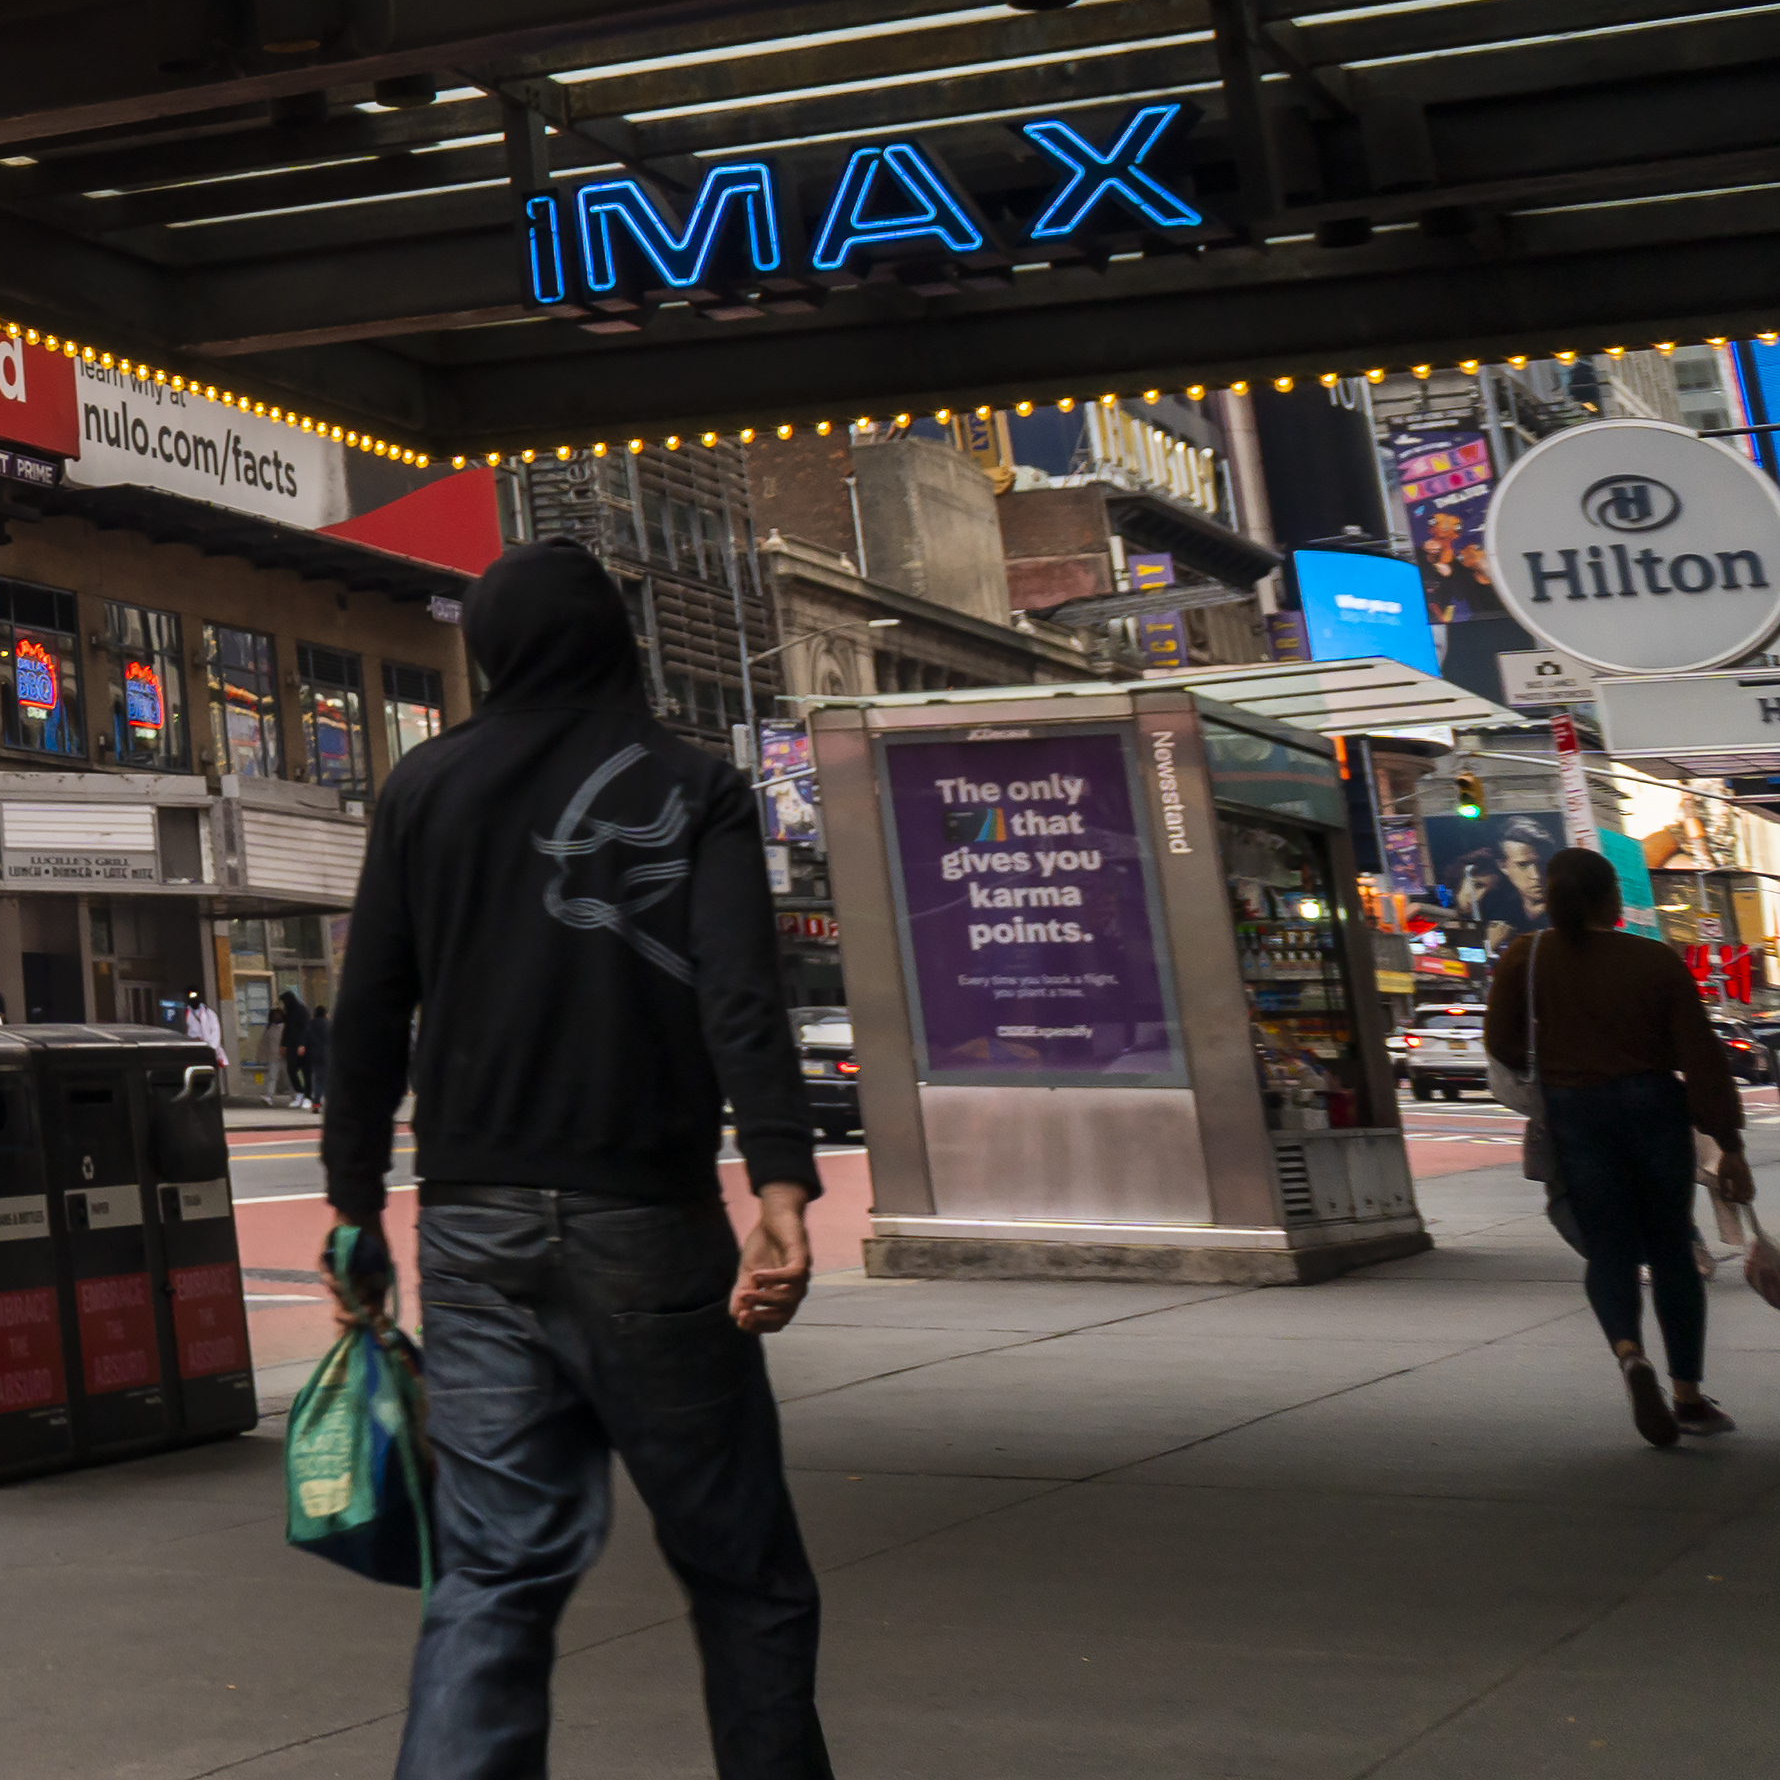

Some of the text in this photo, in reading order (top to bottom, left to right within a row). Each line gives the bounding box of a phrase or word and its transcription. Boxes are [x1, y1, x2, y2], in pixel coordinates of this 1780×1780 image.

[526, 102, 1203, 304] IMAX
[83, 400, 298, 498] nulo.com/facts
[15, 457, 54, 485] PRIME
[1521, 545, 1770, 603] Hilton
[16, 657, 49, 673] DALLAS
[16, 670, 53, 705] BBQ
[126, 680, 157, 696] DALLAS
[935, 773, 1085, 806] The only
[1151, 730, 1193, 855] Newsstand
[1010, 809, 1086, 837] that
[95, 857, 130, 867] GRILL
[941, 847, 1103, 880] gives you
[969, 881, 1083, 909] karma
[969, 917, 1095, 950] points.
[82, 1279, 146, 1314] EMBRACE
[175, 1266, 234, 1300] EMBRACE
